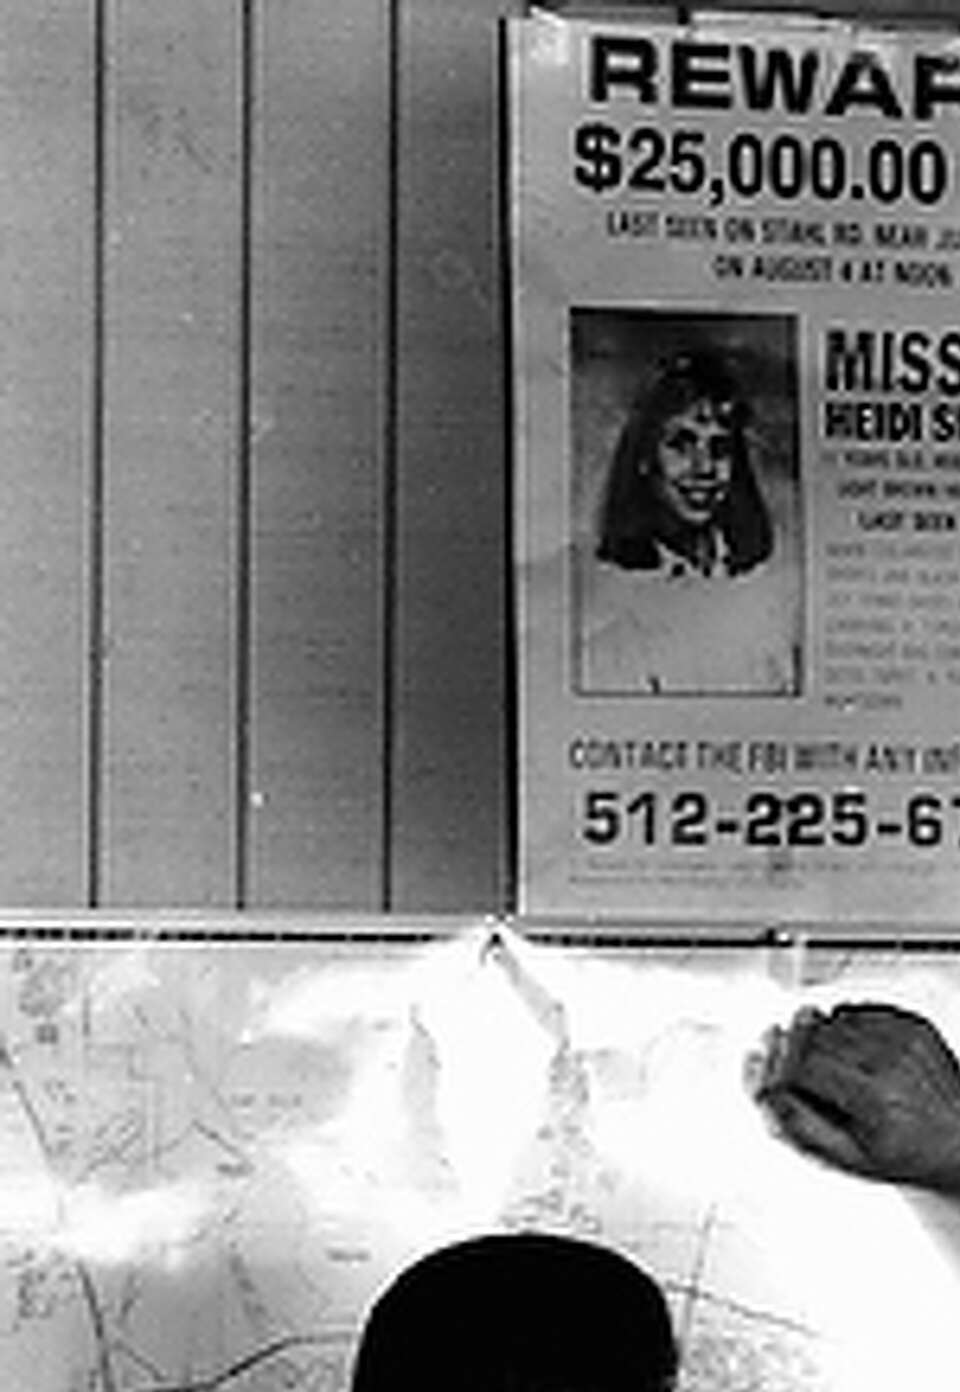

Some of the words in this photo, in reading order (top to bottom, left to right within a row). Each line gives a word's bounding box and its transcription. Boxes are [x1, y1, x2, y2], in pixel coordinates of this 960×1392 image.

[574, 124, 947, 207] $25,000.00
[606, 211, 661, 238] LAST
[666, 215, 718, 239] SEEN
[724, 216, 756, 243] ON
[874, 223, 928, 249] NEAR
[713, 254, 744, 281] ON
[753, 255, 833, 284] AUGUST
[862, 260, 885, 284] AT
[894, 261, 952, 289] NOON
[825, 401, 922, 442] HEIDI
[857, 511, 903, 533] LAST
[569, 740, 687, 771] CONTACT
[696, 741, 743, 775] THE
[748, 741, 788, 776] FBI
[865, 744, 915, 774] ANY
